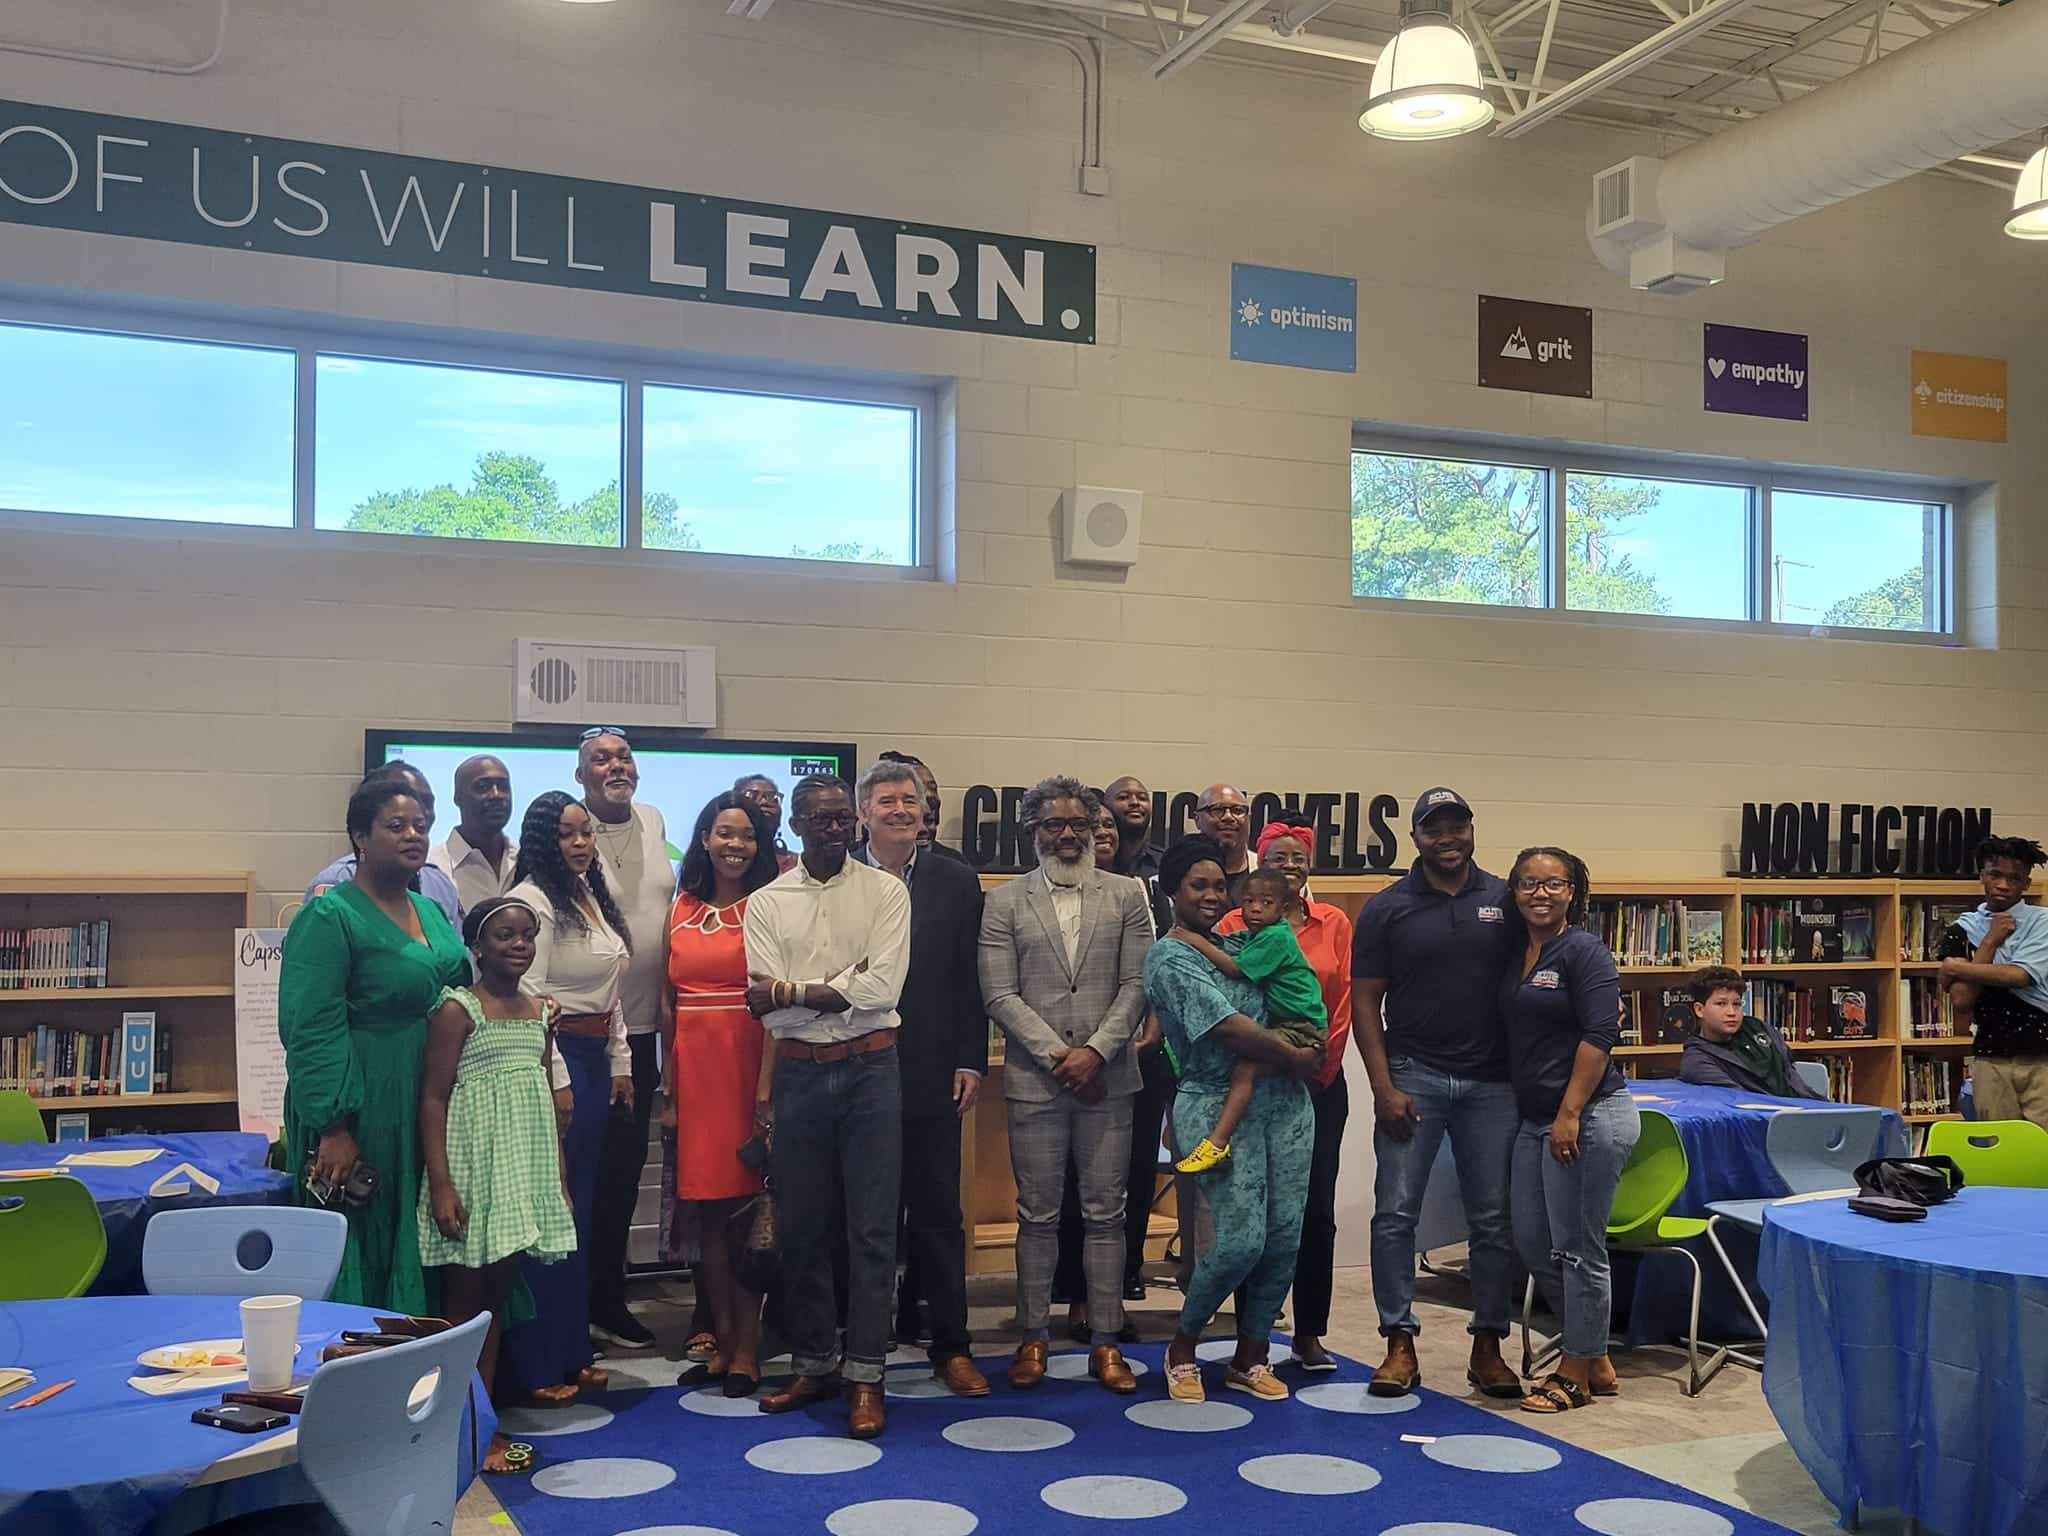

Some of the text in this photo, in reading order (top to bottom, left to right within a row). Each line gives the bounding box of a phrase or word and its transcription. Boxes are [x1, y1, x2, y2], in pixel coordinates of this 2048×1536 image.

[0, 124, 1081, 331] OF US WILL LEARN.
[1270, 305, 1354, 334] optimism
[1537, 337, 1573, 363] grit
[1731, 360, 1806, 390] empathy
[1935, 387, 2005, 413] citizenship
[962, 785, 1400, 869] GRIC OVELS
[1739, 802, 1992, 874] NON FICTION
[240, 932, 285, 972] Caps
